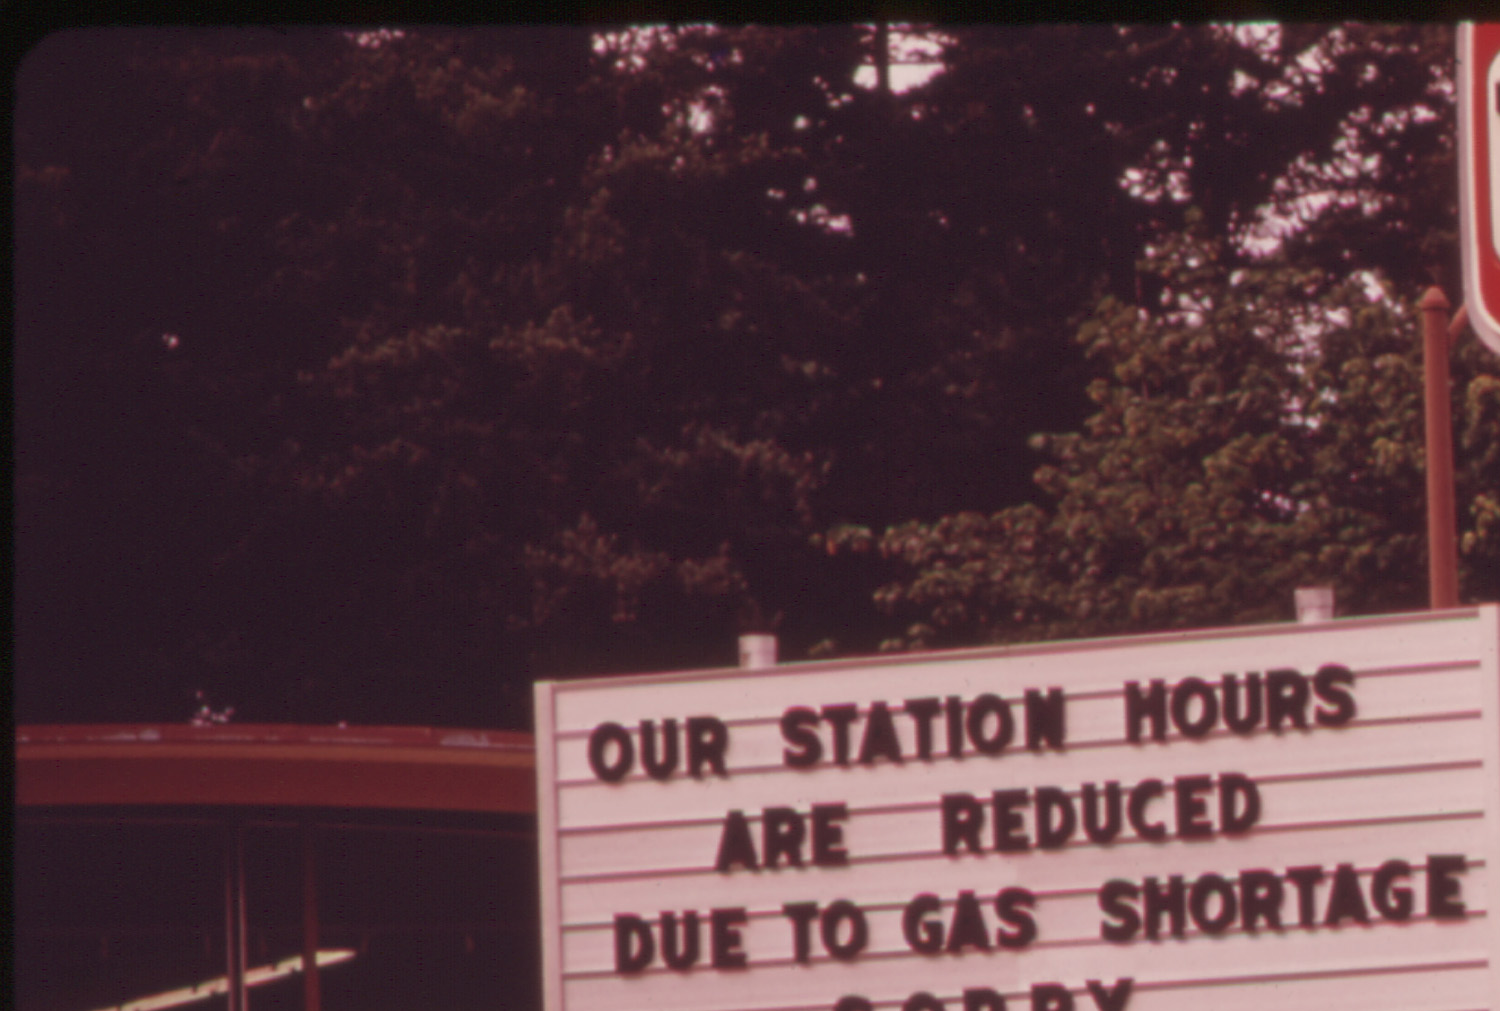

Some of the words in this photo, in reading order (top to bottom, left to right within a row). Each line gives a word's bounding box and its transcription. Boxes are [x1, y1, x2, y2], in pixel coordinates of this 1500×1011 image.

[588, 716, 729, 786] OUR
[779, 686, 1066, 769] STATION
[1123, 663, 1356, 745] HOURS
[715, 803, 850, 874] ARE
[940, 773, 1262, 857] REDUCED
[613, 907, 750, 978] DUE
[782, 900, 870, 966] TO
[902, 887, 1039, 956] GAS
[1098, 854, 1468, 944] SHORTAGE
